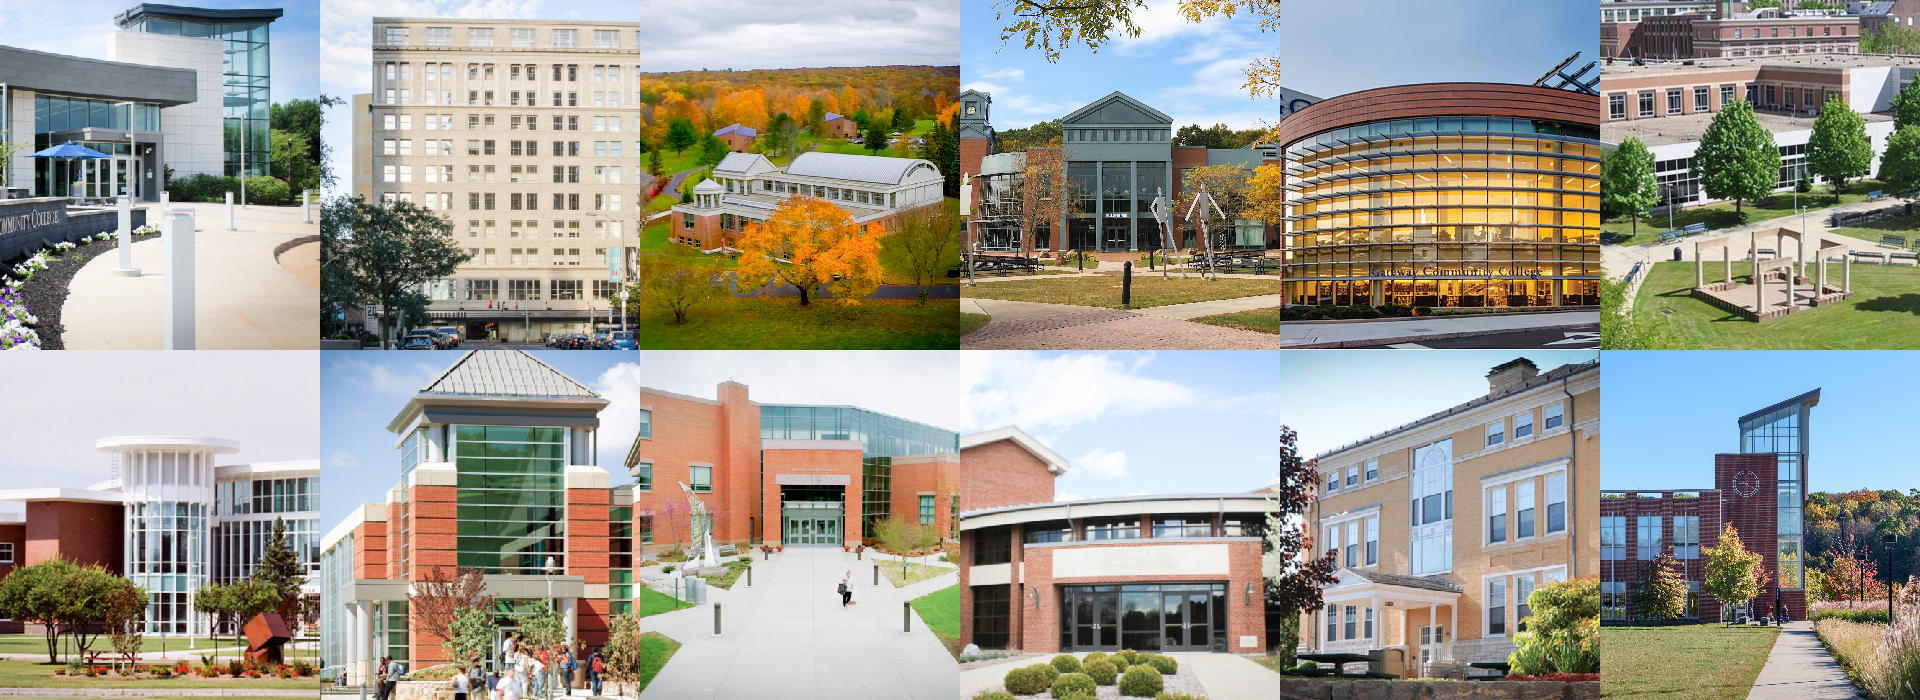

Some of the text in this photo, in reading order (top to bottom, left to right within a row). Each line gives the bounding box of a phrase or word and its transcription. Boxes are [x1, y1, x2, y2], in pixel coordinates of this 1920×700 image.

[1371, 265, 1543, 279] Gateway Community College
